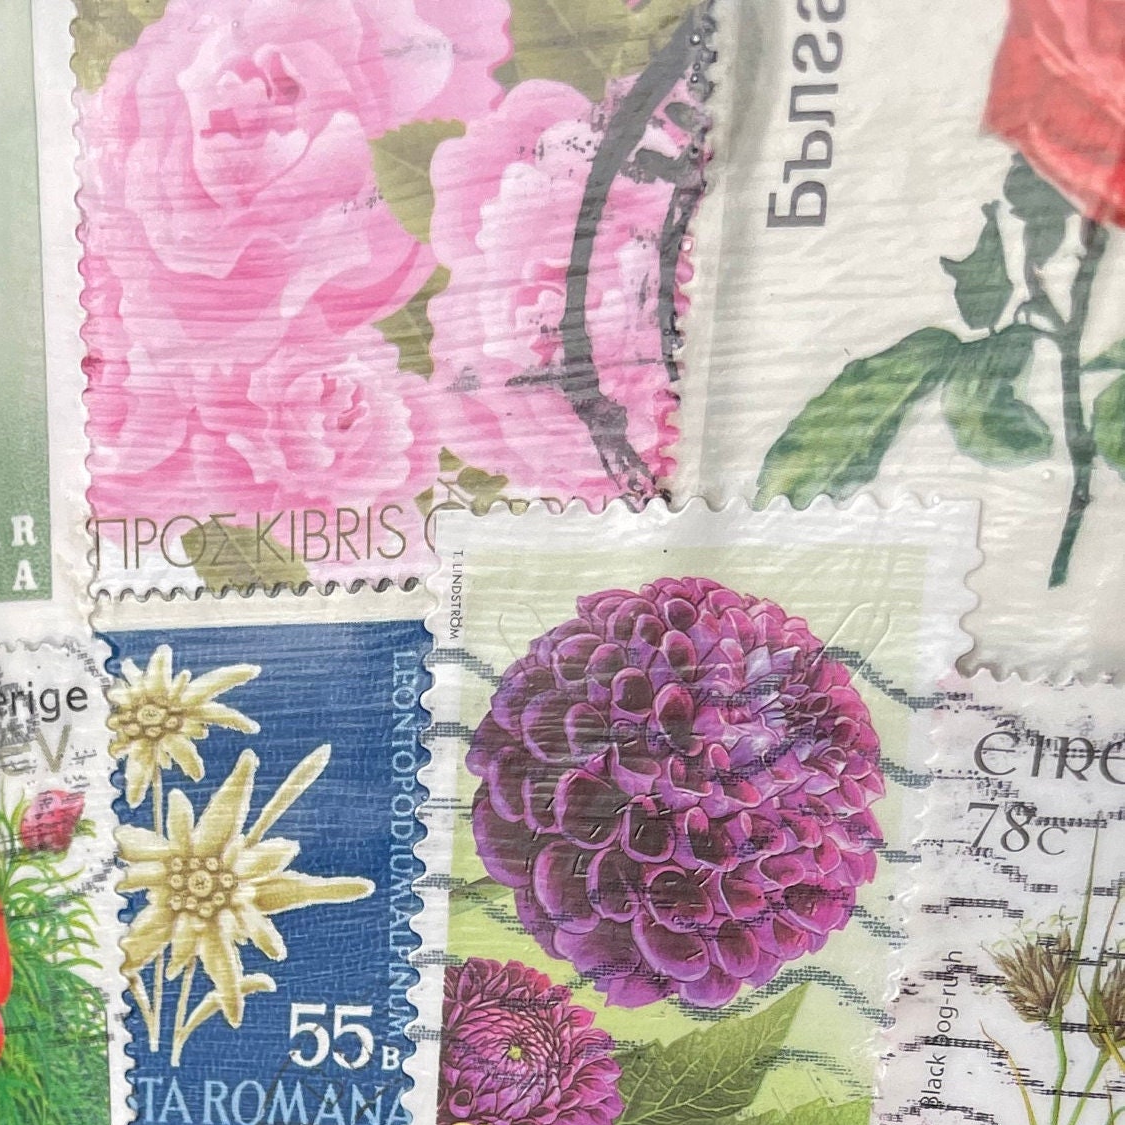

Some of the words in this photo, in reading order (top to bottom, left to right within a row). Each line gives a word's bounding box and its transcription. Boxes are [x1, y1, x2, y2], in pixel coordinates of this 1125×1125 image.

[256, 503, 407, 565] KIBRIS
[449, 563, 464, 640] LINDSTRÖM
[288, 1002, 374, 1070] 55
[126, 1076, 193, 1125] TA
